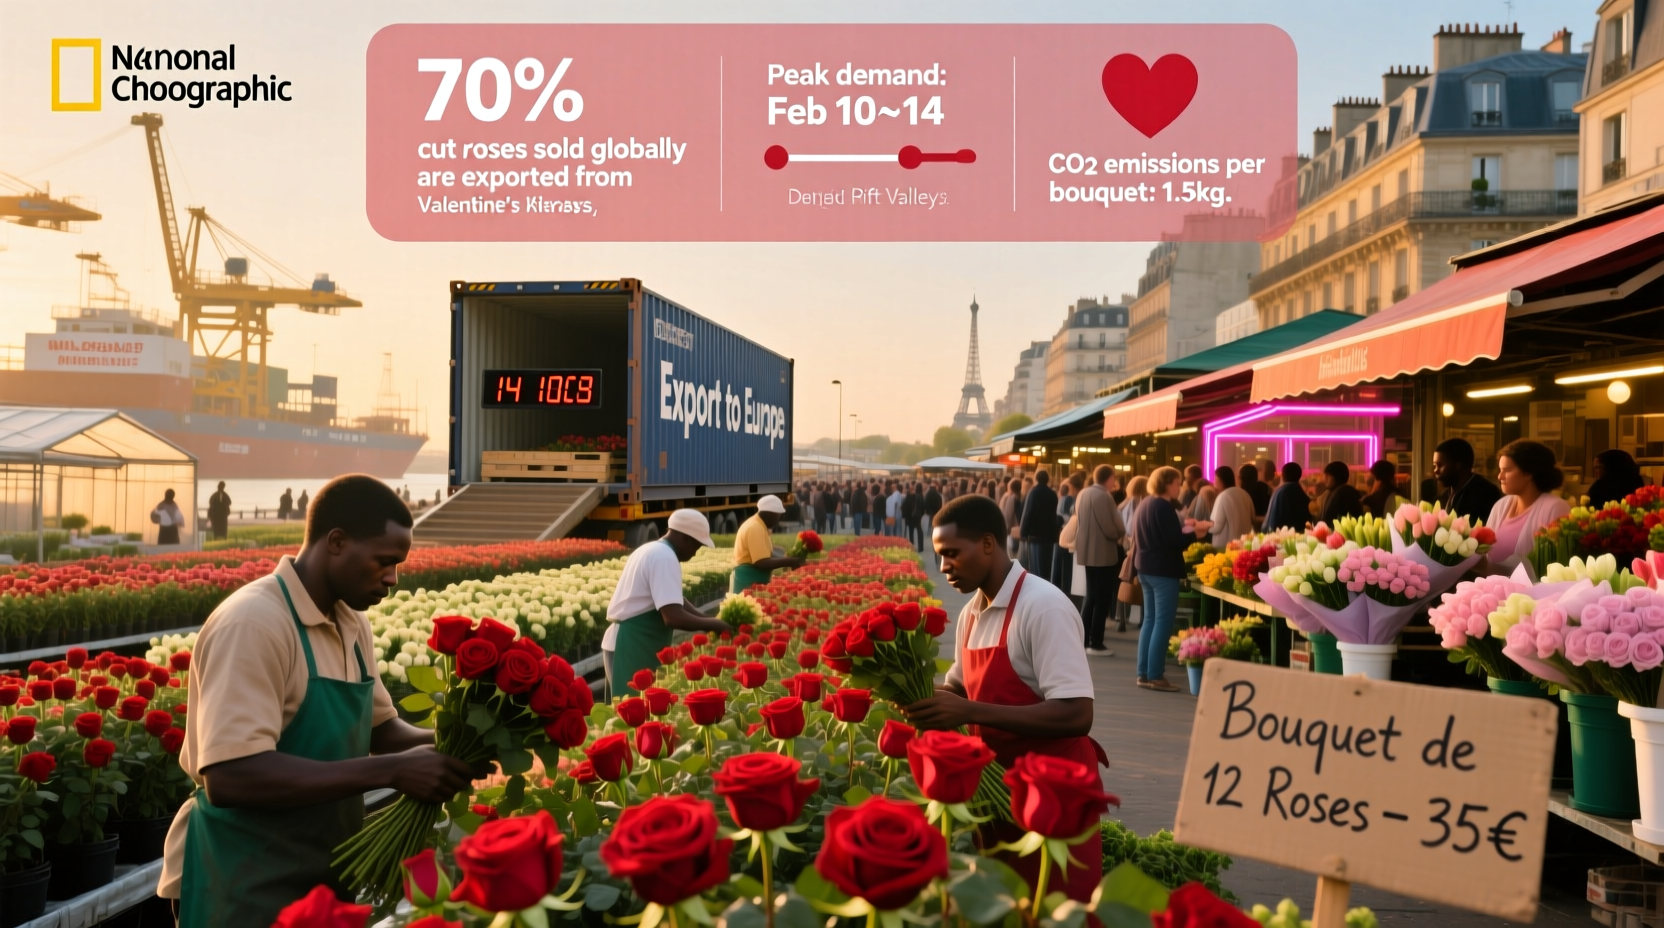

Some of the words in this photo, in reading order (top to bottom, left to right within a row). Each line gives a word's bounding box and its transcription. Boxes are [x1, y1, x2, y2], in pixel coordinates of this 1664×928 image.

[497, 376, 522, 402] 14
[660, 360, 722, 439] Export
[725, 384, 742, 432] to
[1220, 680, 1402, 775] Bouquet
[1421, 715, 1477, 772] de
[1203, 762, 1243, 808] 12
[1263, 766, 1370, 832] Roses
[1420, 798, 1528, 862] 35€
